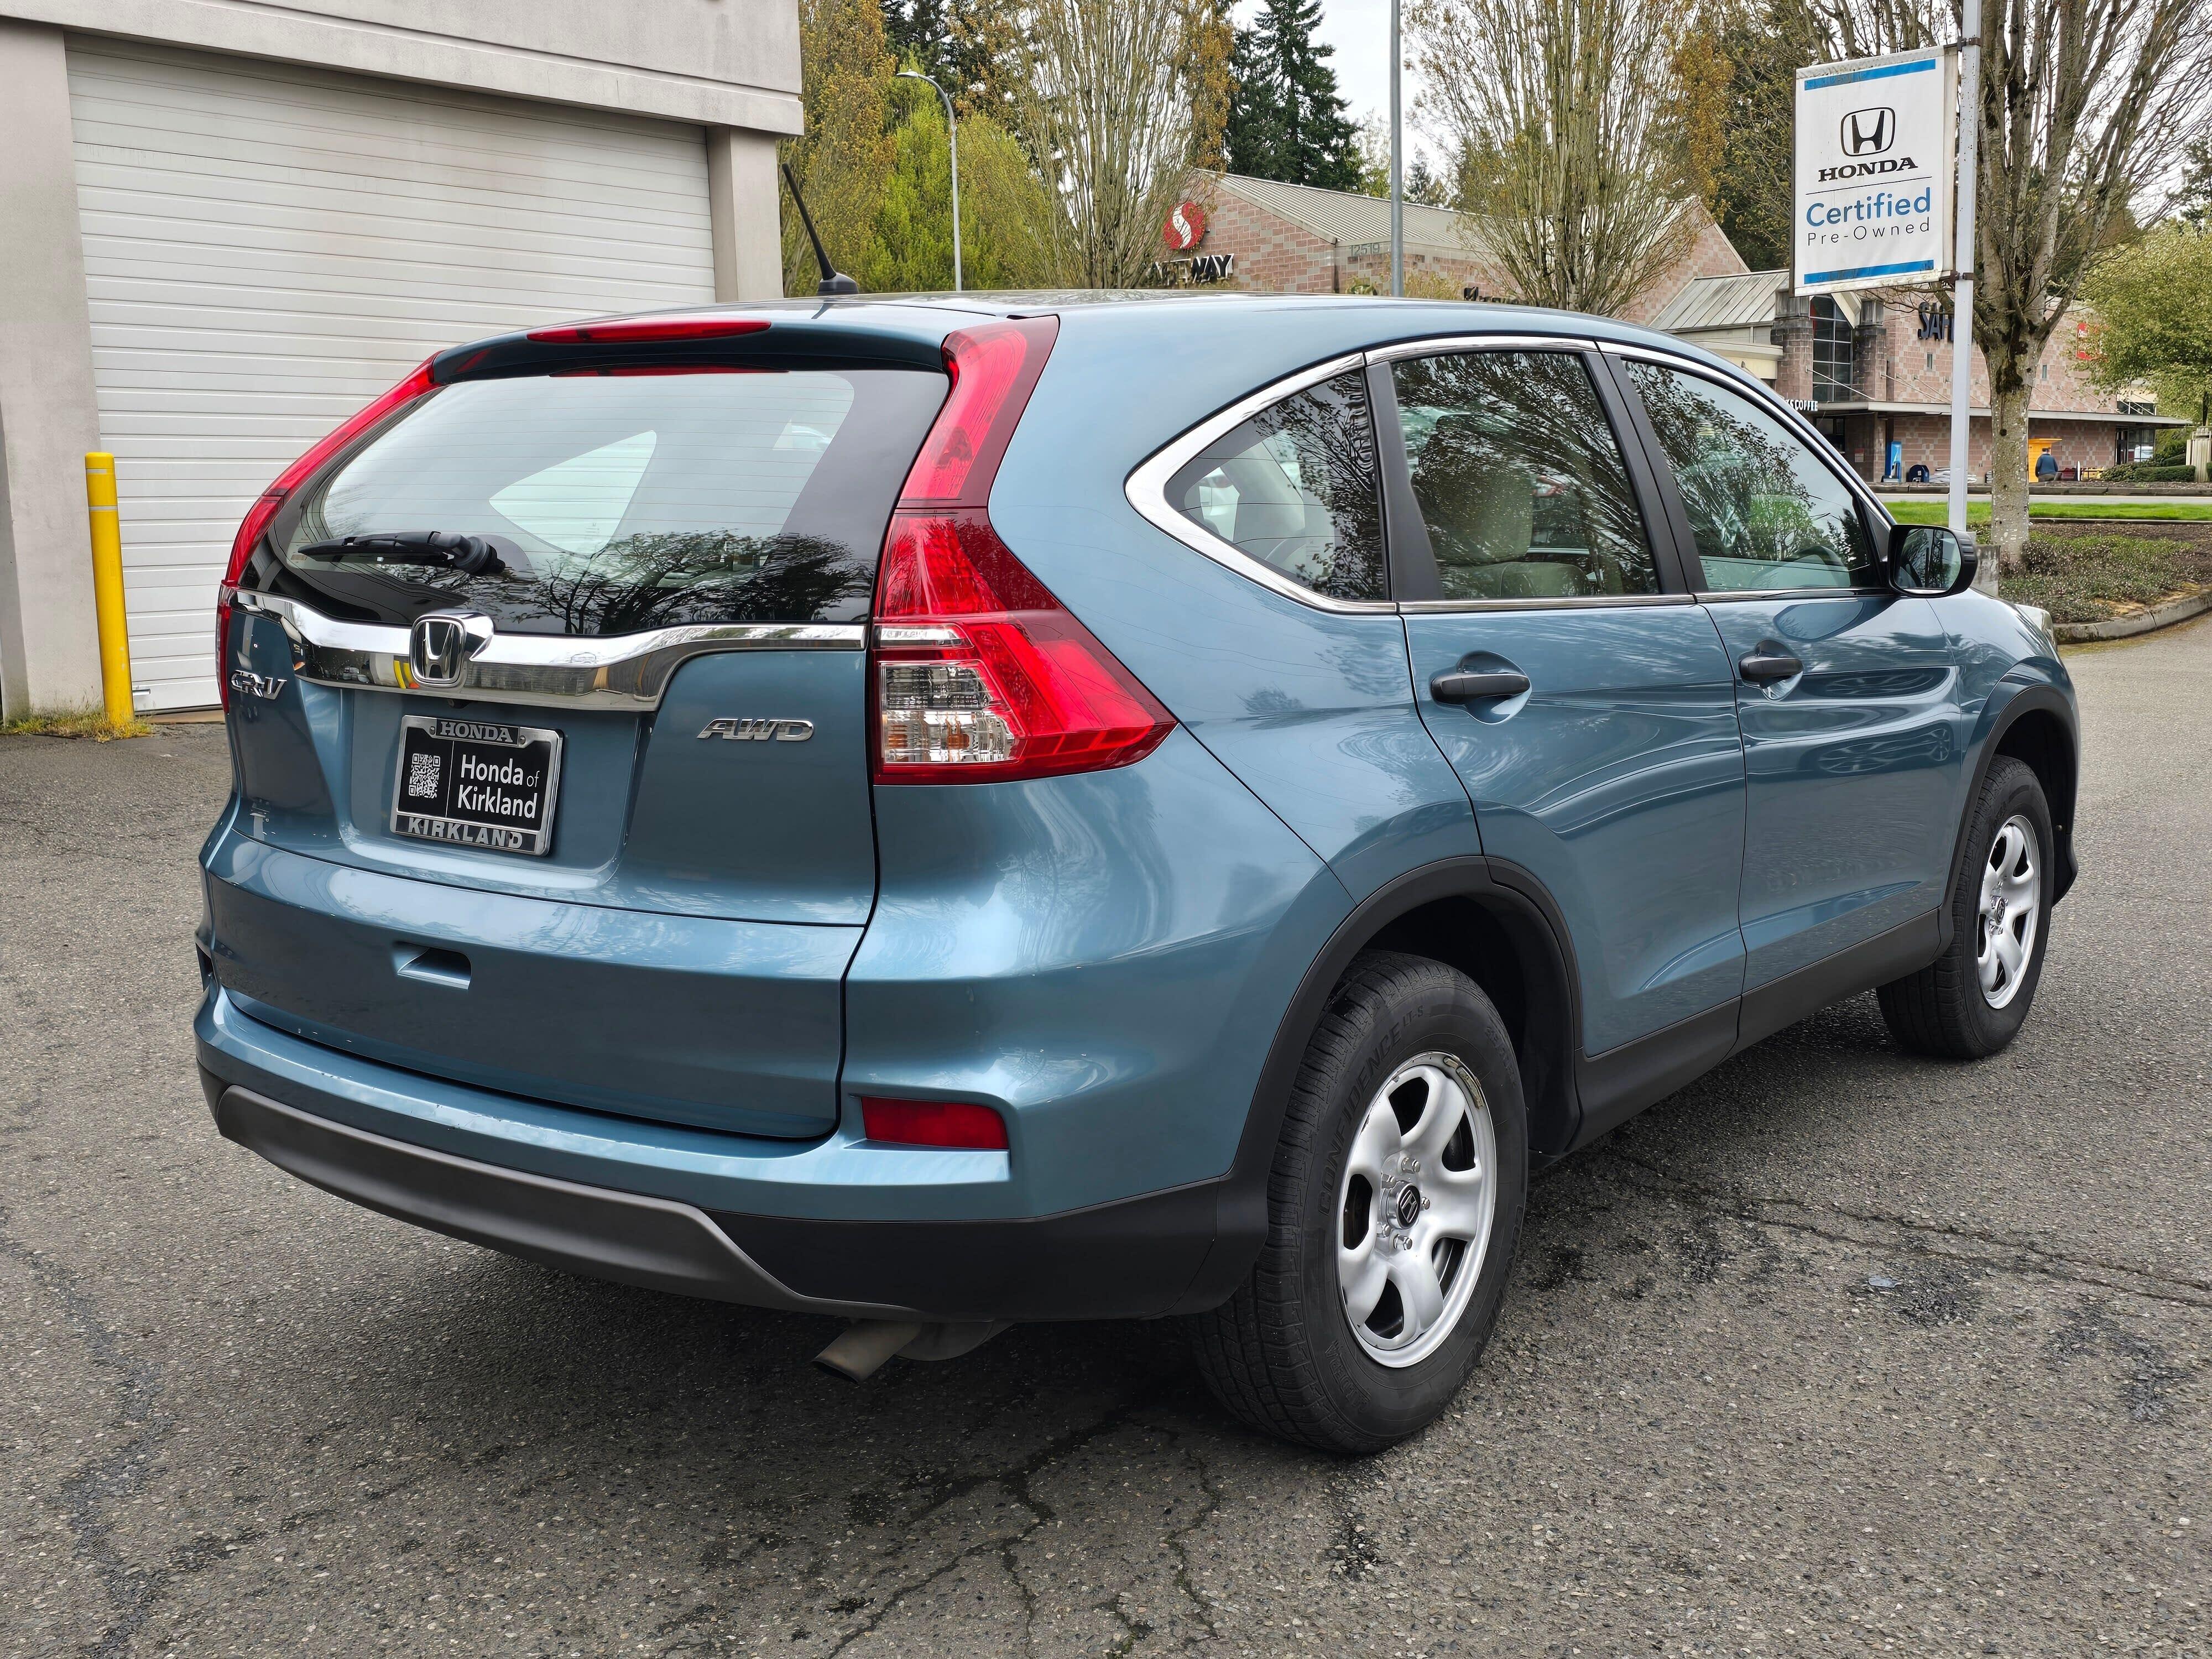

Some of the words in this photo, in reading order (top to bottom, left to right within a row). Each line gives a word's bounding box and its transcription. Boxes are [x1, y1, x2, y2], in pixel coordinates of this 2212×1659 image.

[1818, 156, 1918, 182] HONDA
[1806, 186, 1931, 227] Certified
[1808, 217, 1929, 246] Pre-Owned
[1794, 399, 1818, 411] COFFEE
[440, 721, 513, 743] HONDA
[697, 718, 814, 741] AWD
[461, 754, 524, 786] Honda
[526, 770, 540, 788] of
[457, 784, 538, 819] Kirkland
[408, 817, 523, 849] KIRKLAND
[1318, 1022, 1402, 1216] CONFIDENCE
